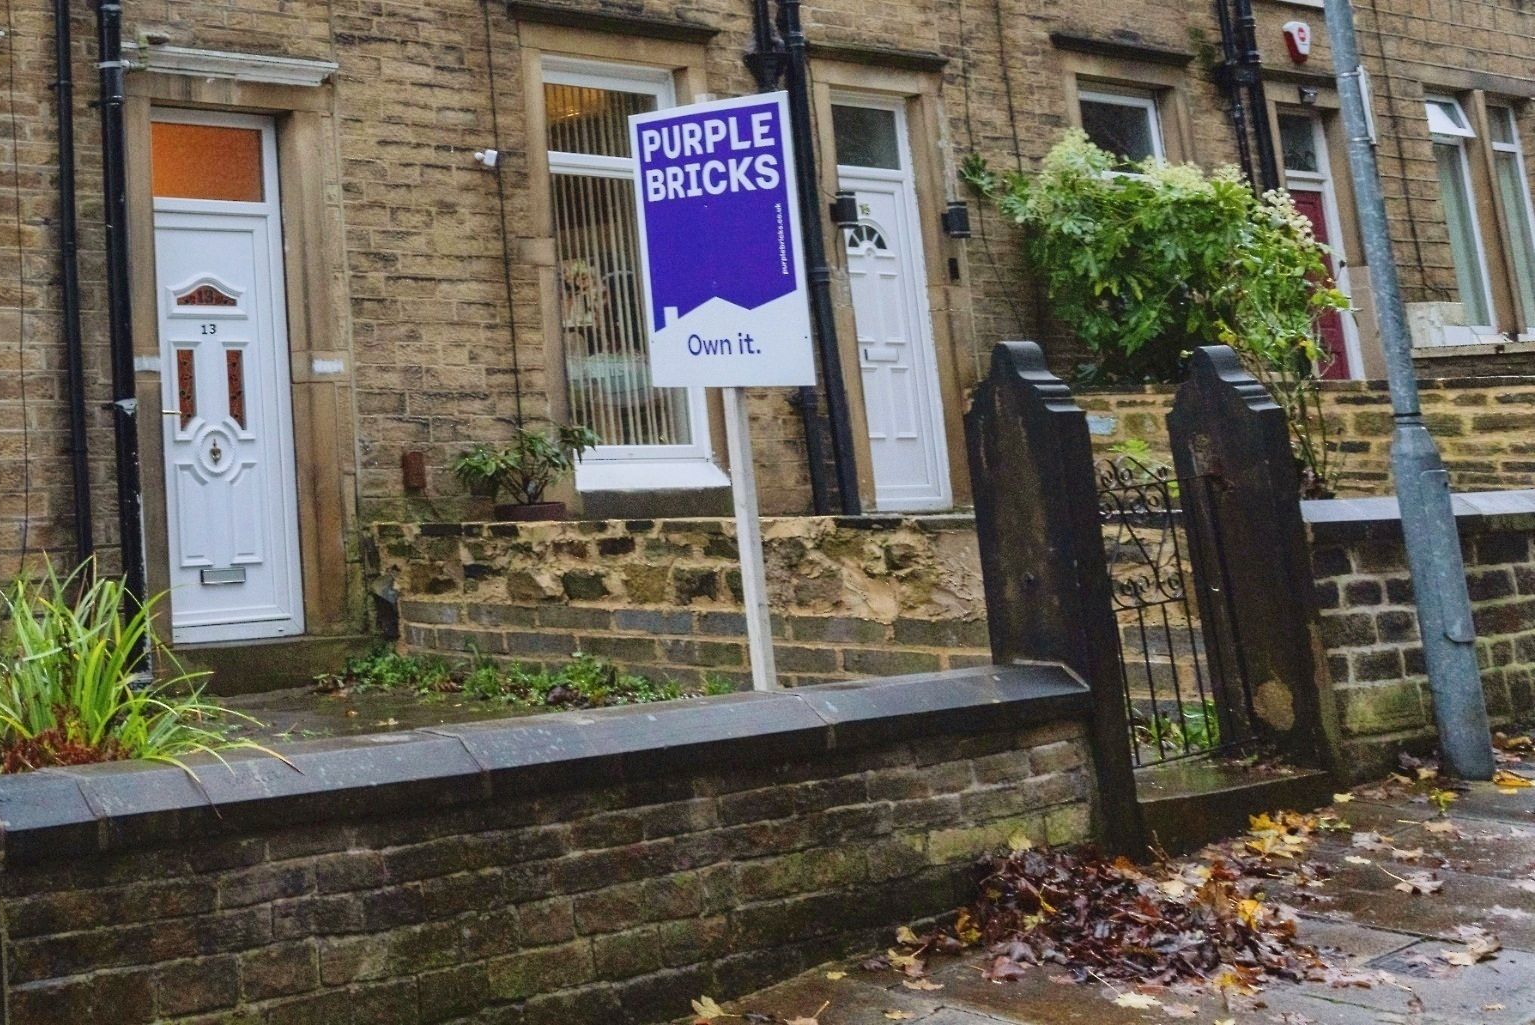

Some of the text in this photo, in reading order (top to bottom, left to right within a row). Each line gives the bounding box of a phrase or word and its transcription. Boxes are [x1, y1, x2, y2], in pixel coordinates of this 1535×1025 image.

[642, 112, 776, 163] PURPLE
[645, 154, 781, 202] BRICKS
[201, 323, 217, 335] 13
[688, 332, 762, 356] Own it.
